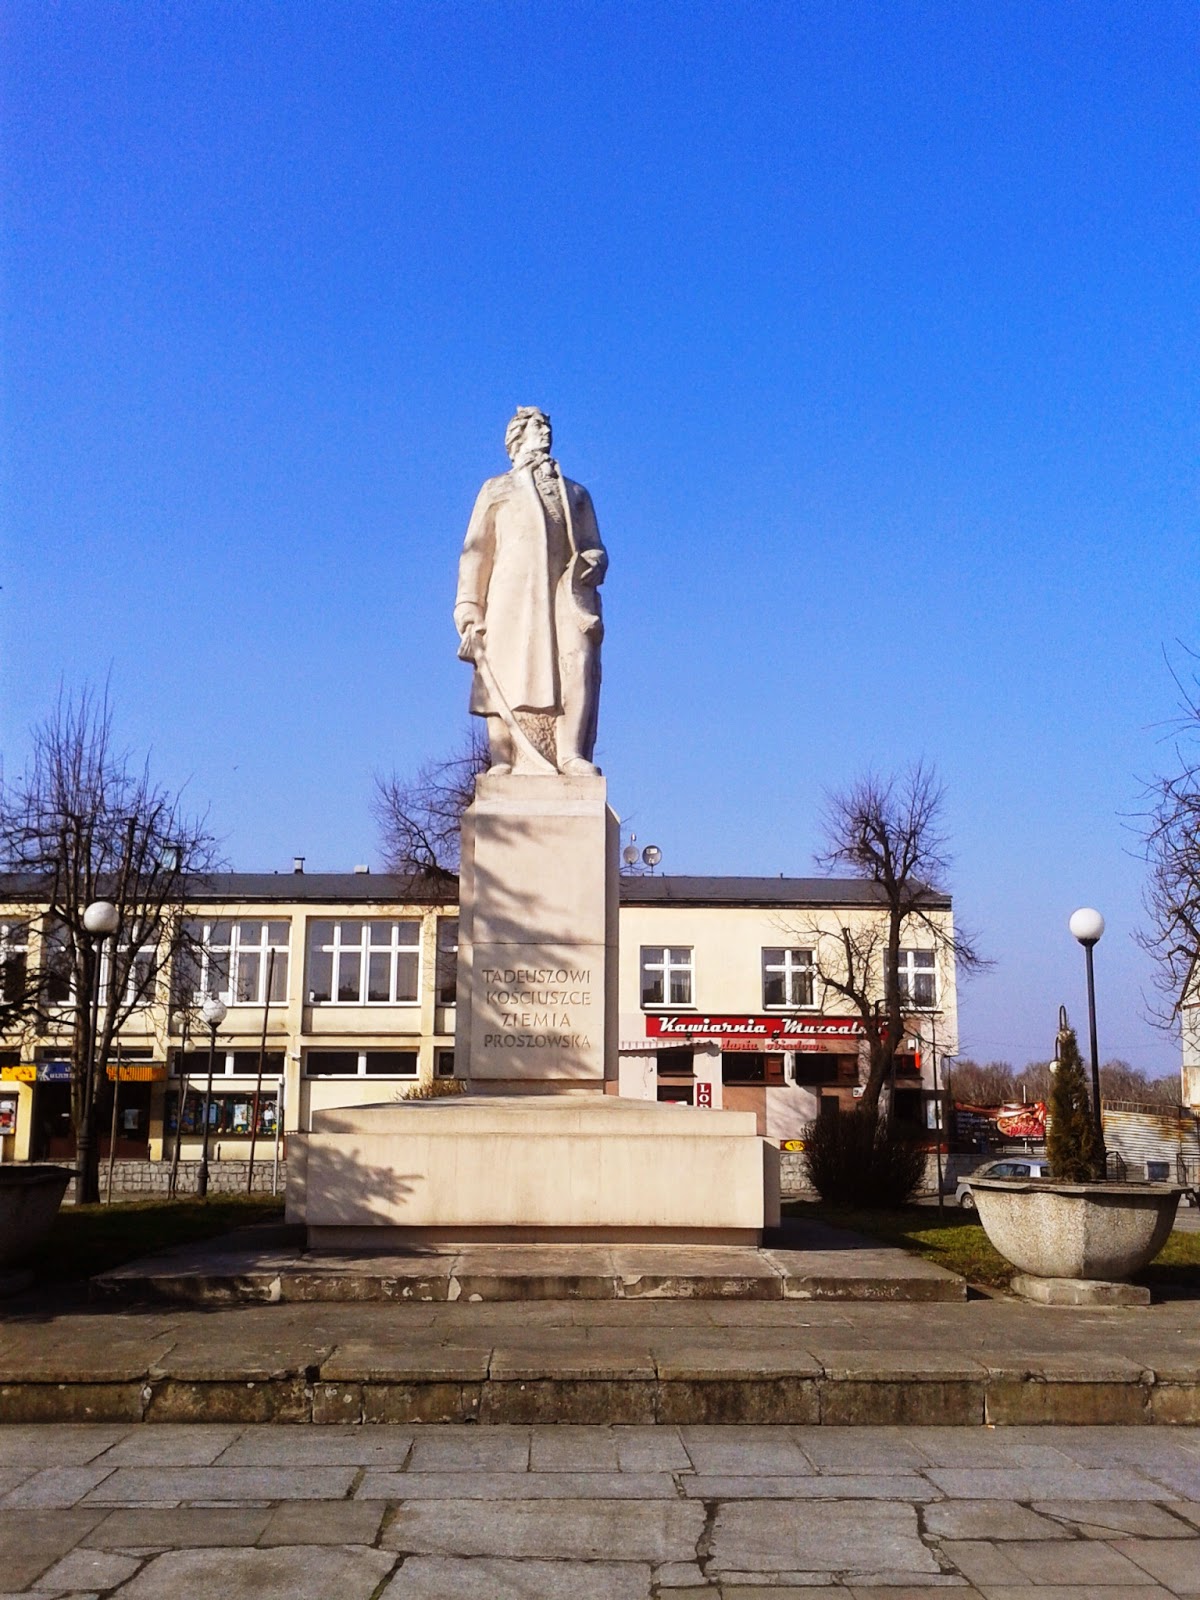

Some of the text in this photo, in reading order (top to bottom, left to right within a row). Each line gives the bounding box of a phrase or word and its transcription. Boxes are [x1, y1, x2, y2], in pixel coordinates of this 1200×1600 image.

[482, 969, 591, 984] TADEUSZOWI
[486, 988, 591, 1005] KOŚCIUSZCE
[501, 1013, 571, 1027] ZIEMIA
[658, 1017, 767, 1033] Kawiarnia
[484, 1034, 591, 1048] PROSZOWSKA
